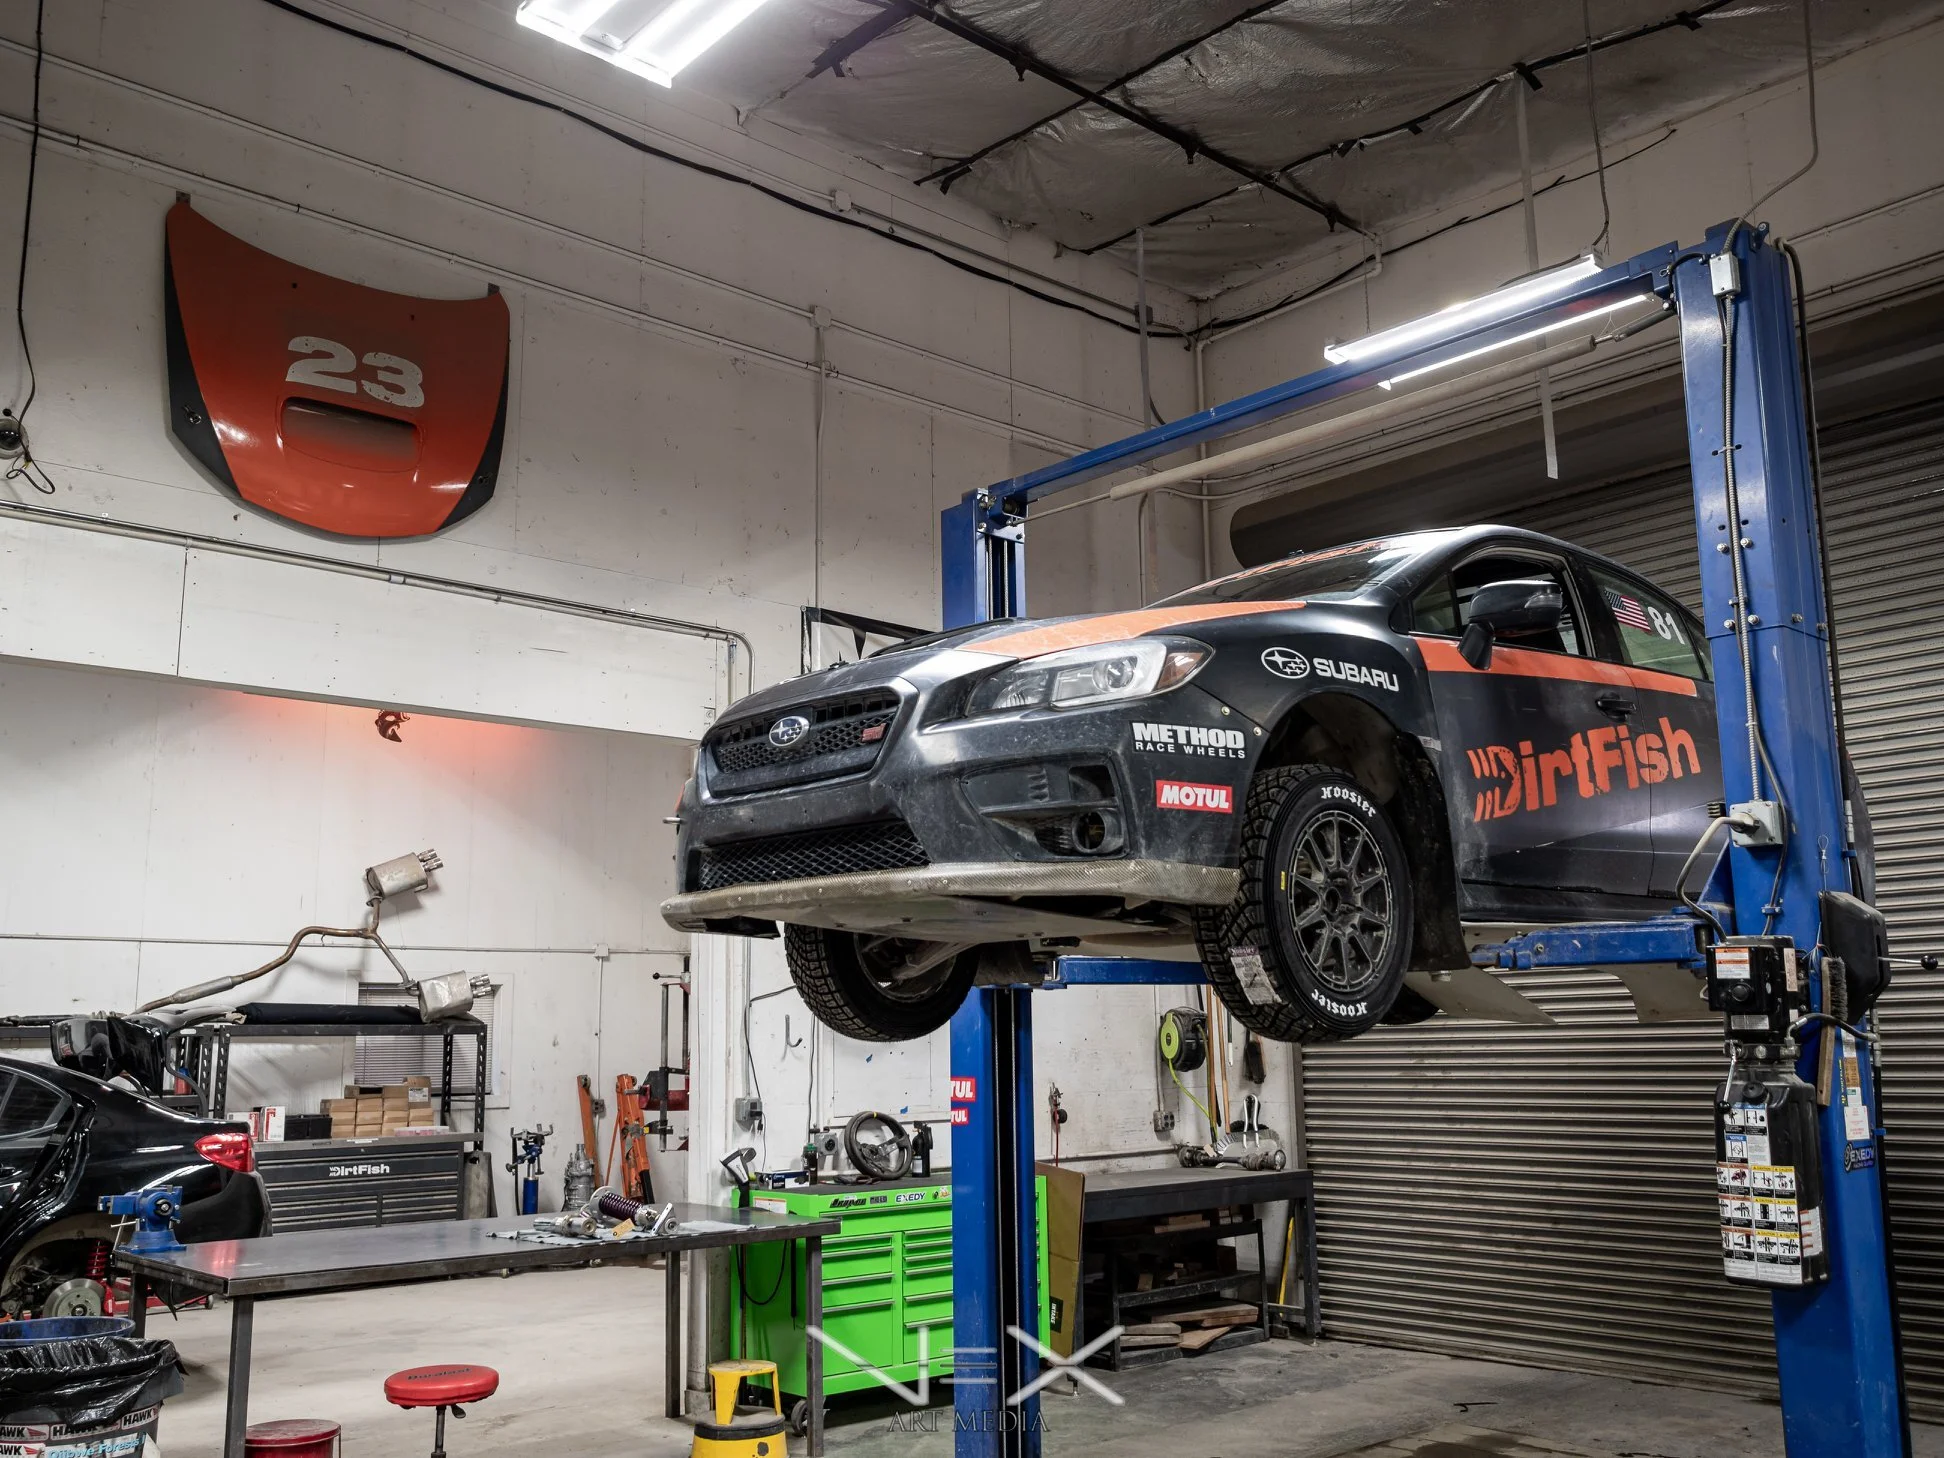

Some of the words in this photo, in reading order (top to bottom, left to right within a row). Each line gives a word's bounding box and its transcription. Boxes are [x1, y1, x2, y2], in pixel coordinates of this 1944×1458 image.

[285, 336, 425, 408] 23
[1647, 606, 1686, 645] 81
[1312, 657, 1400, 692] SUBARU
[1131, 722, 1246, 749] METHOD
[1135, 741, 1176, 753] RACE
[1183, 745, 1246, 759] WHEELS
[1466, 717, 1701, 823] DirtFish
[1160, 784, 1230, 809] MOTUL
[896, 1193, 925, 1203] EXEDY
[123, 1408, 152, 1426] HAWK
